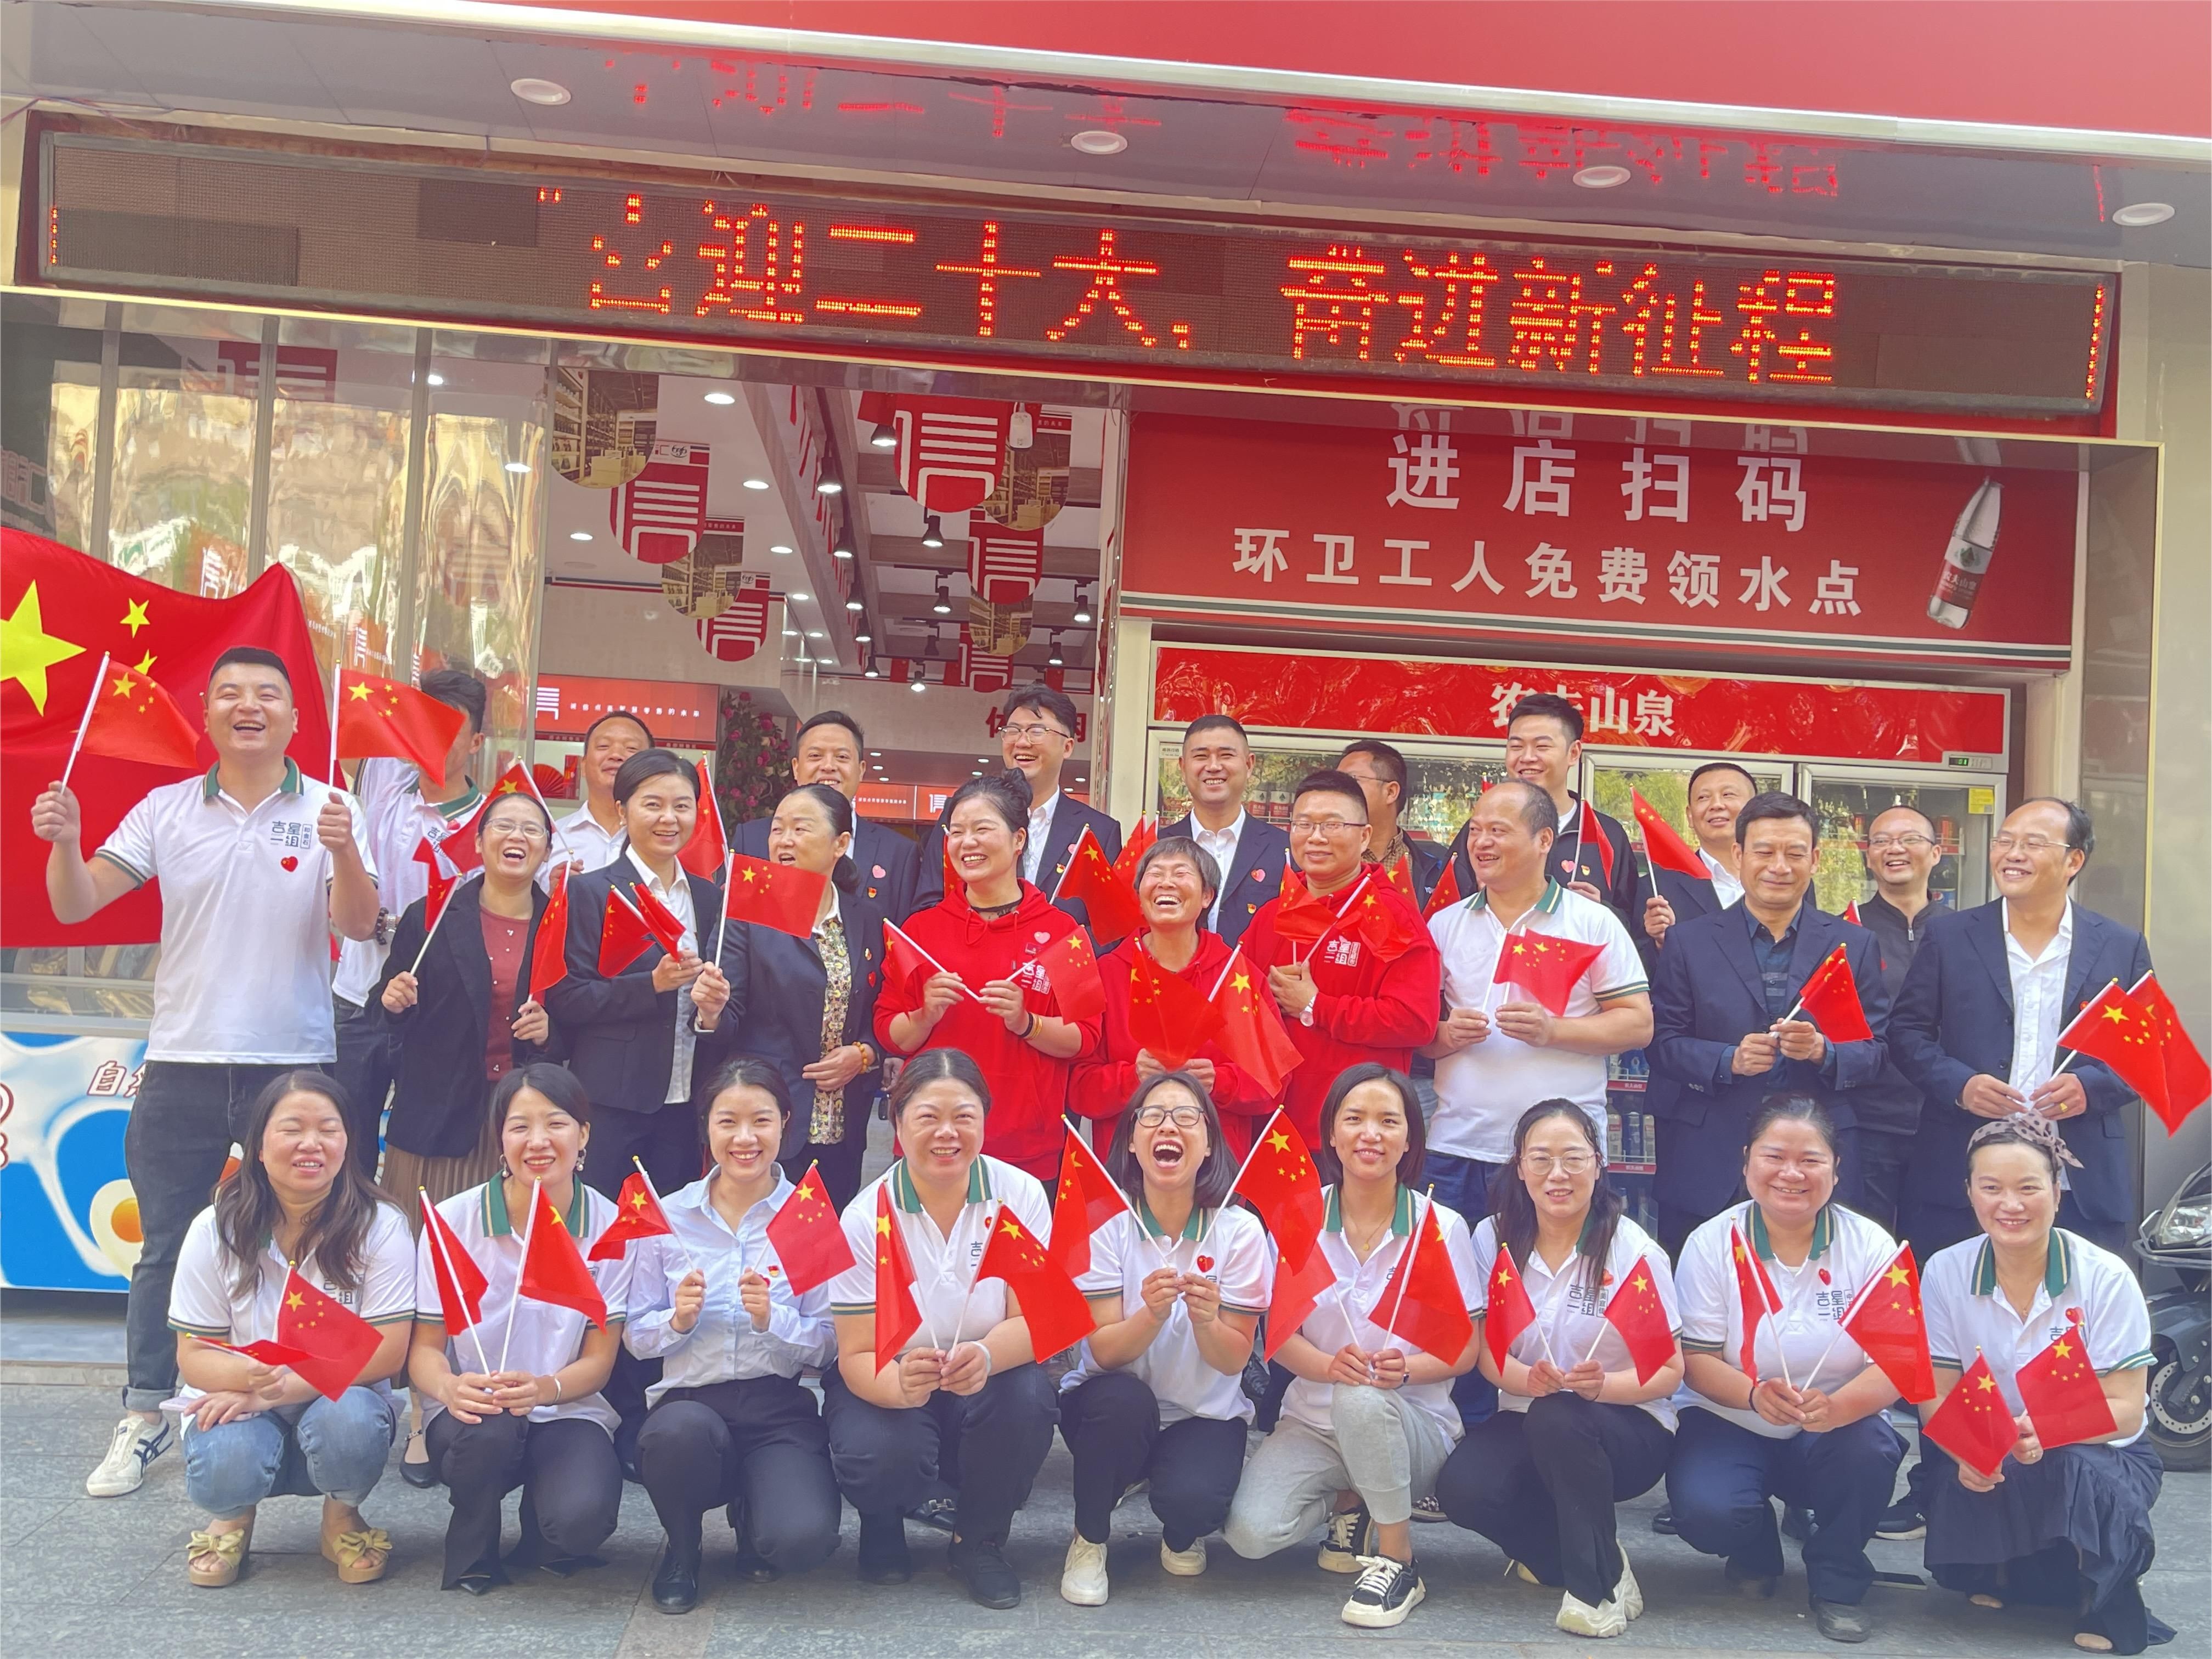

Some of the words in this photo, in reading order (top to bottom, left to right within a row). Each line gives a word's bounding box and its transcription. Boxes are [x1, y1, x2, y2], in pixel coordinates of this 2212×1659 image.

[1386, 433, 1807, 532] 进店扫码
[1233, 528, 1861, 617] 环卫工人免费领水点
